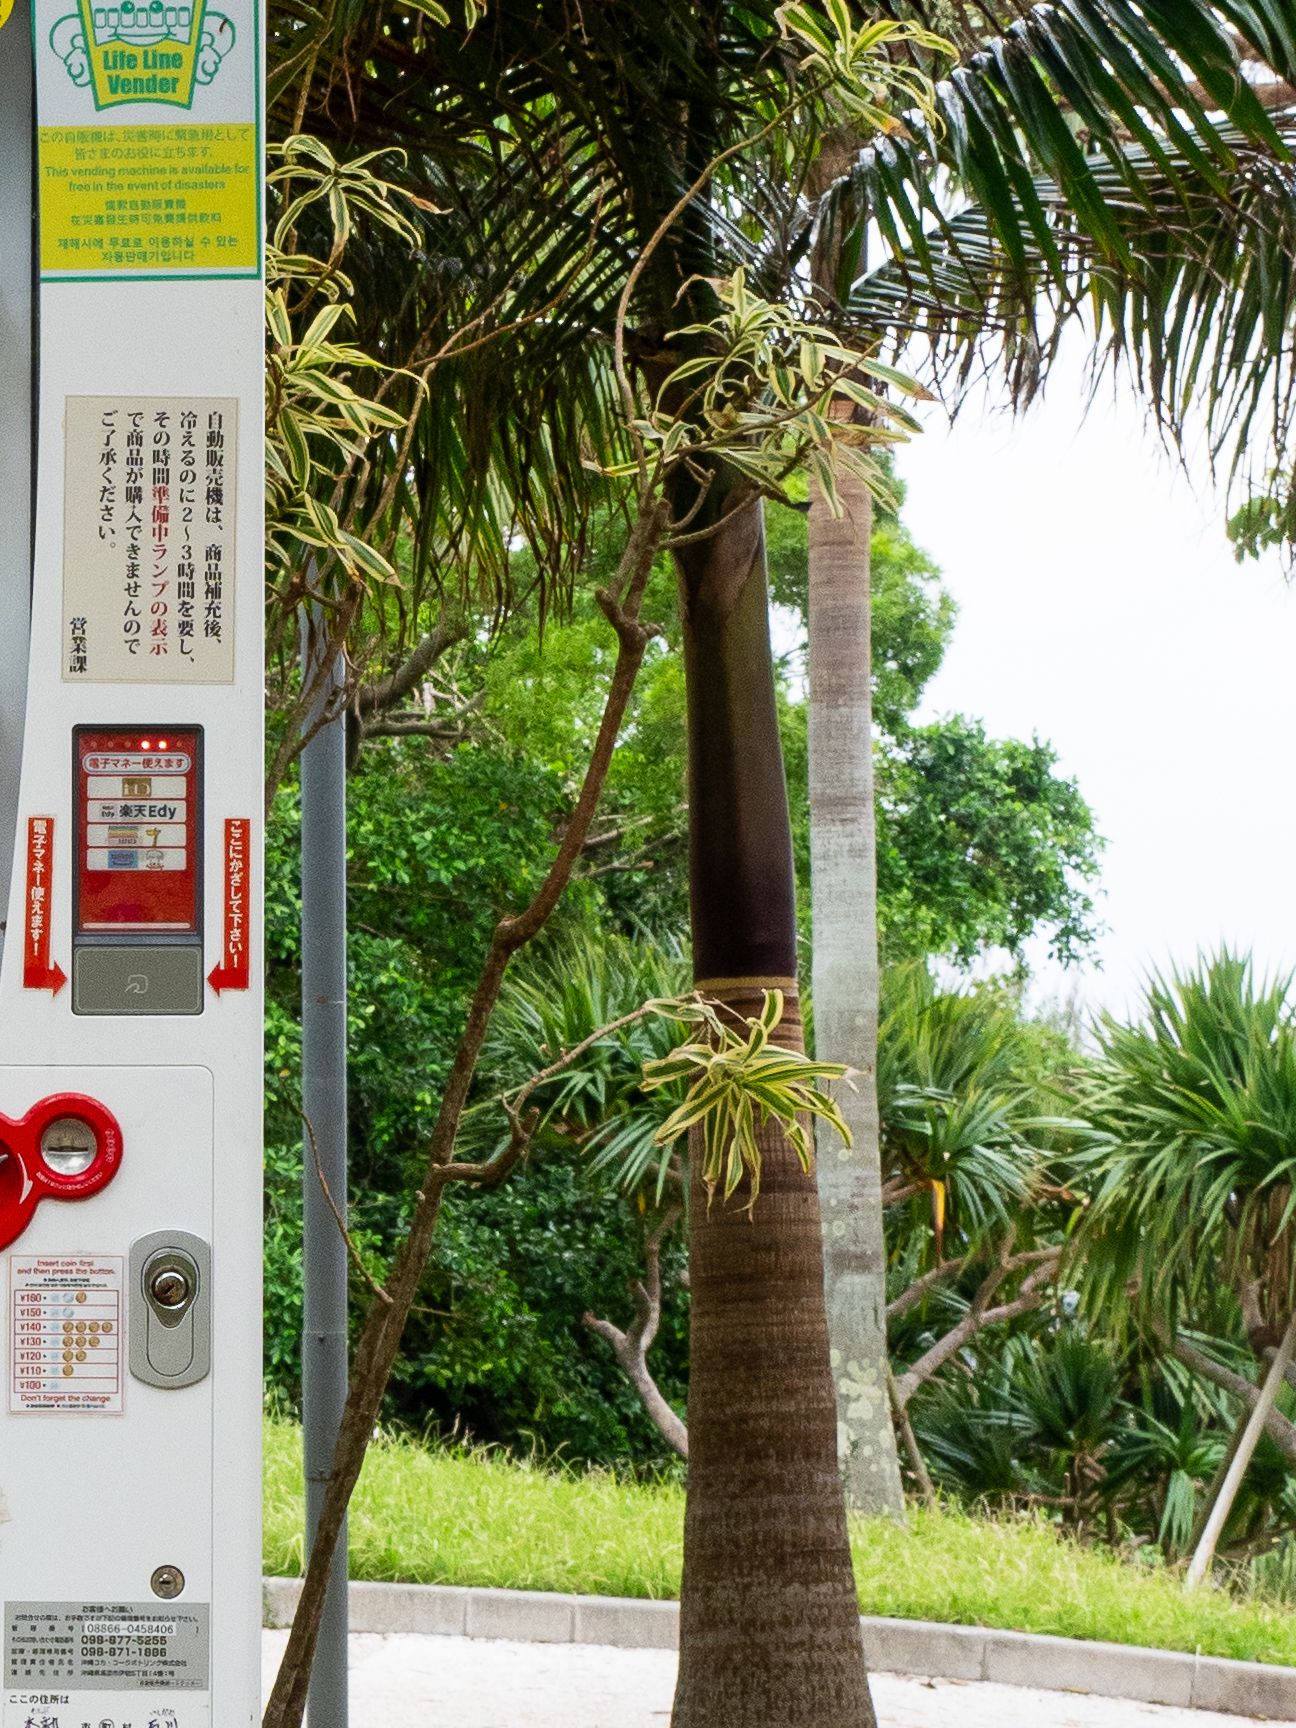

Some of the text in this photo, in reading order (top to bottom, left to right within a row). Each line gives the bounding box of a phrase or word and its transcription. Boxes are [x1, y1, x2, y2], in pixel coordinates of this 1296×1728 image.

[103, 49, 183, 71] Life Line
[45, 167, 68, 177] This
[71, 166, 116, 178] vending
[118, 166, 166, 176] machine
[181, 165, 230, 175] available
[234, 164, 249, 174] for
[69, 182, 91, 191] free
[106, 181, 124, 191] the
[127, 182, 158, 191] event
[160, 180, 172, 190] of
[98, 409, 118, 549] ご了承ください。
[123, 411, 144, 654] で商品が購入できませんので
[204, 411, 225, 644] 自動販売機は、商品補充後、
[149, 411, 171, 656] その時間準備中ランプの表示
[69, 617, 88, 673] 営業課
[88, 758, 185, 769] 電子マネー使えます
[119, 804, 177, 820] 楽天Edy
[20, 1309, 41, 1317] ¥150
[20, 1323, 41, 1331] ¥140
[20, 1338, 41, 1346] ¥130
[20, 1352, 41, 1360] ¥120
[20, 1367, 41, 1375] ¥110
[43, 1395, 66, 1403] forget
[87, 1623, 174, 1633] 08866-0458406
[9, 1694, 69, 1704] ここの住所は
